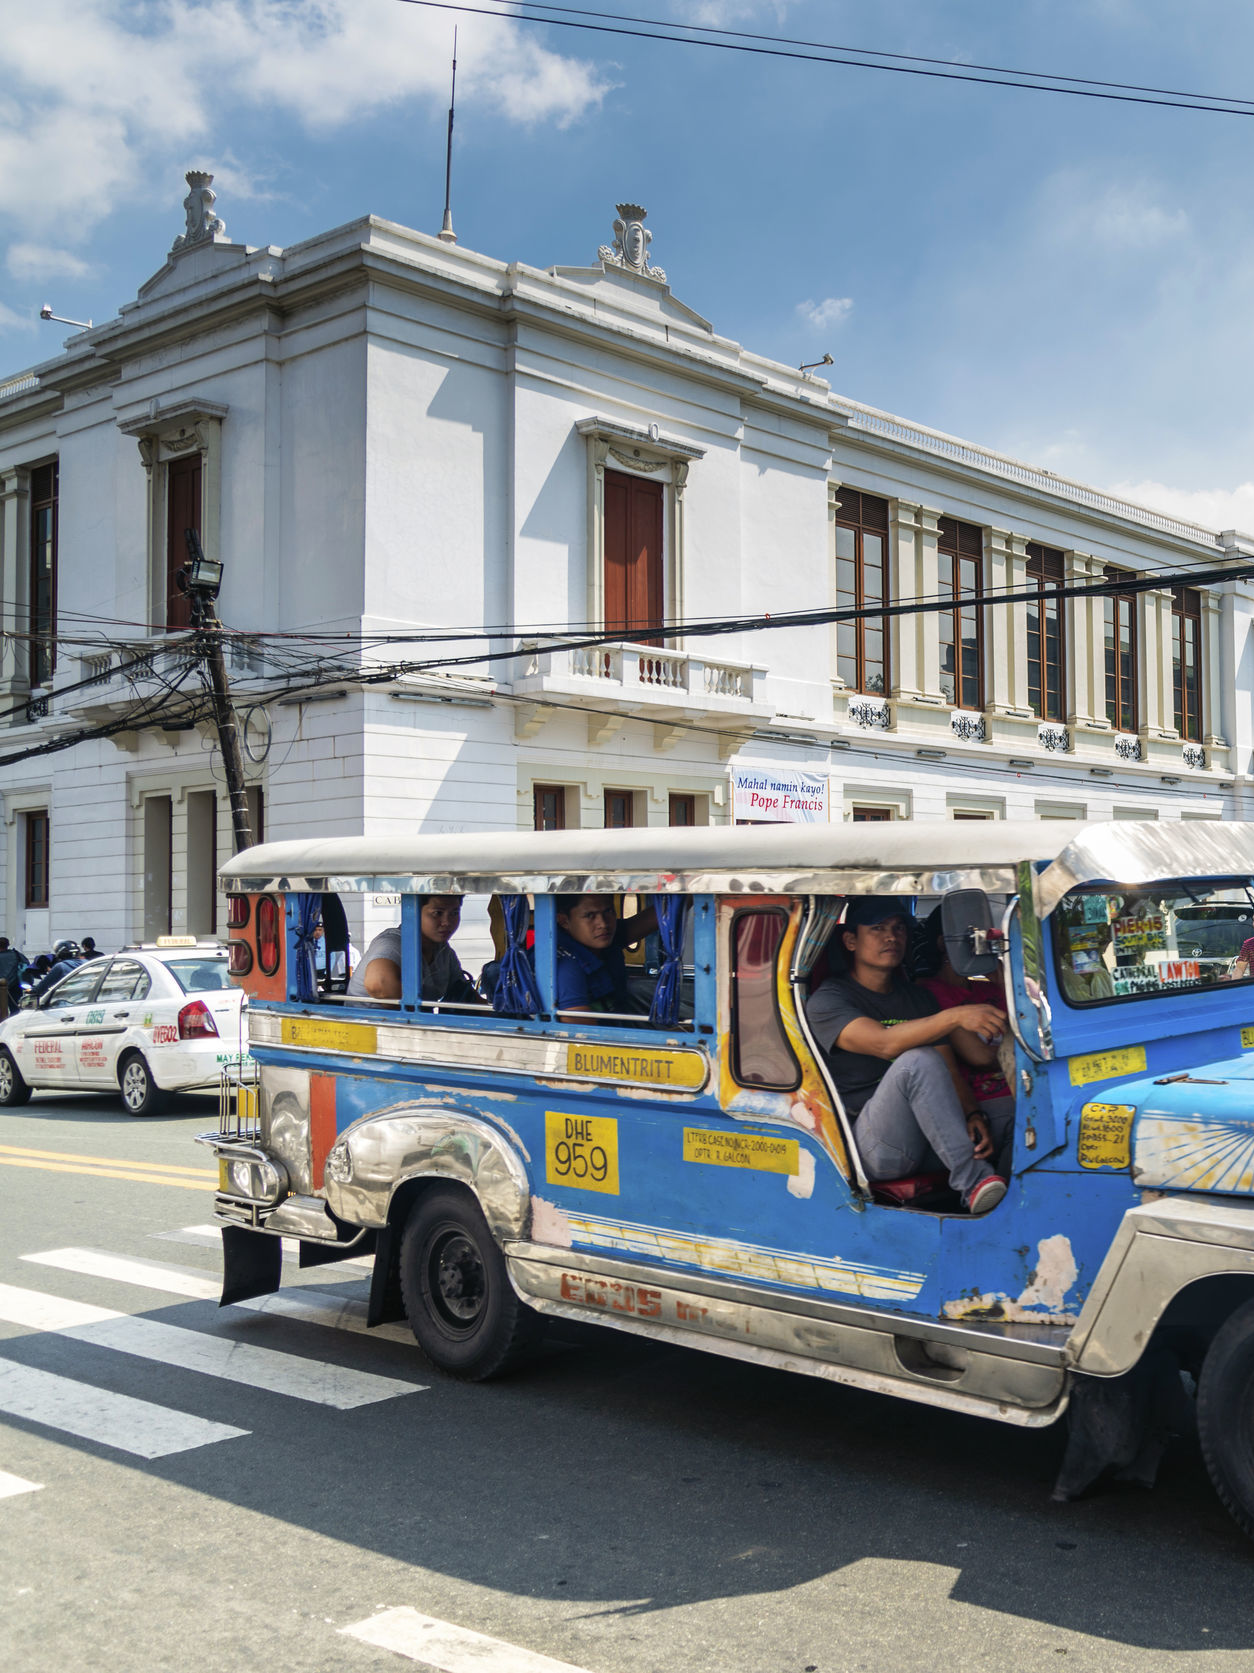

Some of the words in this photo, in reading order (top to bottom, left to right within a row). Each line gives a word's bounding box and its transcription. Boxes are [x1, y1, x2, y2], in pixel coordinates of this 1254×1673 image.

[737, 777, 767, 790] Mahal
[770, 781, 798, 792] namin
[801, 782, 824, 797] kayo!
[751, 793, 779, 812] Pope
[782, 795, 823, 811] Francis
[216, 1054, 232, 1062] MAY
[574, 1053, 674, 1078] BLUMENTRITT
[565, 1118, 593, 1142] DHE
[708, 1134, 724, 1148] CASE
[555, 1141, 608, 1182] 959
